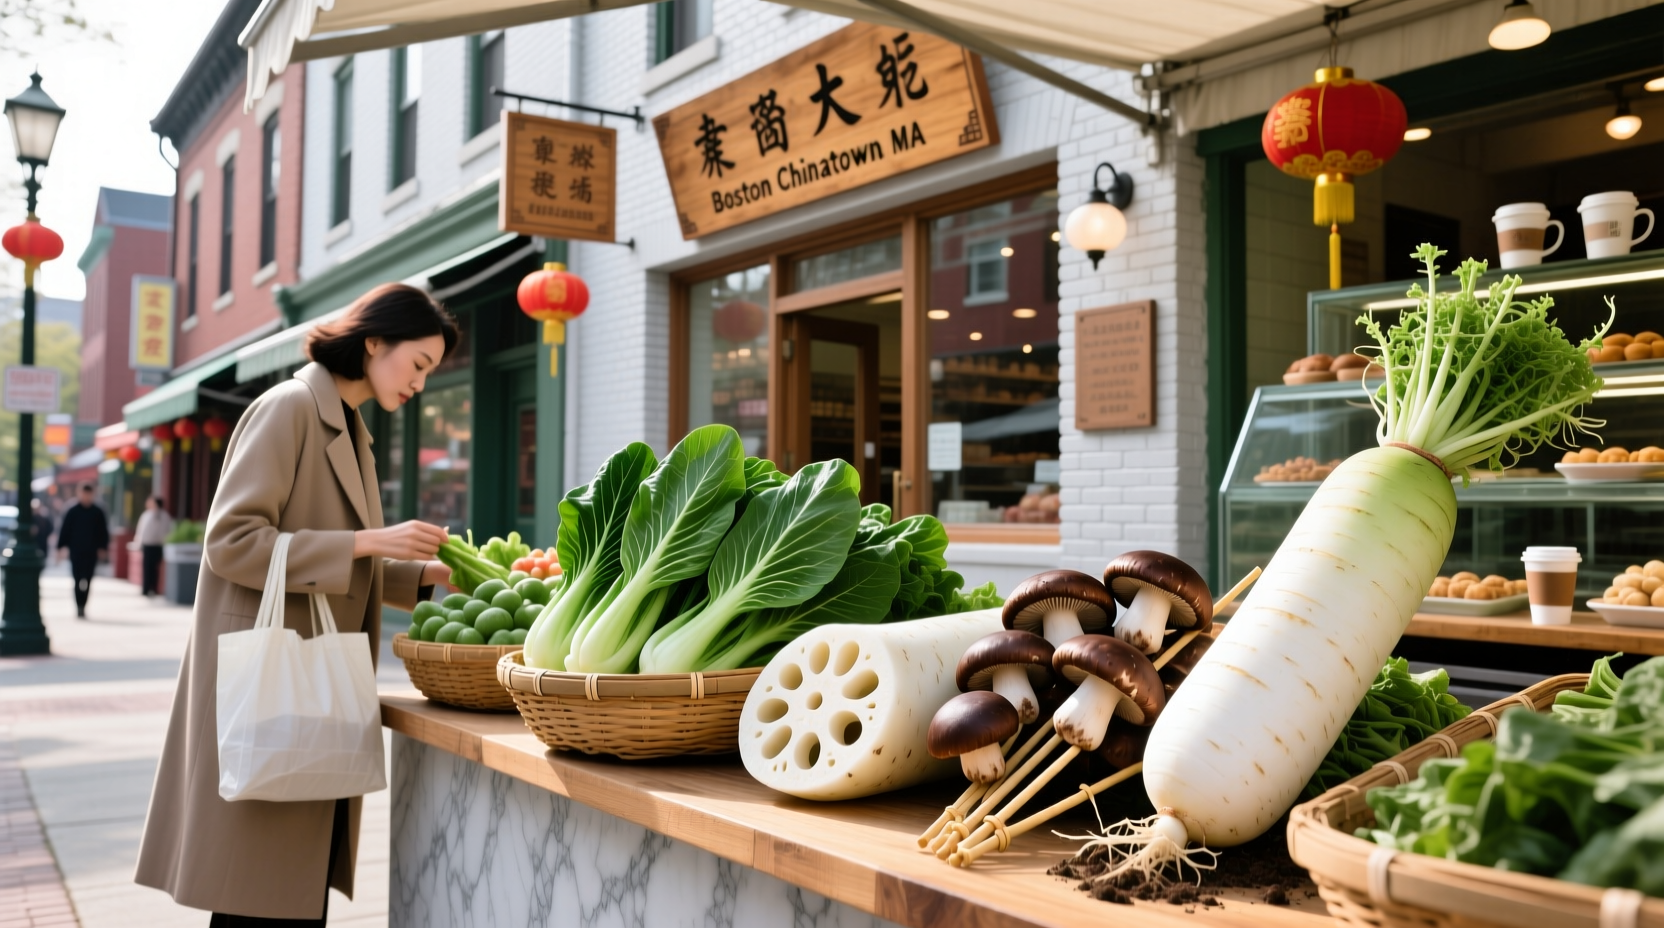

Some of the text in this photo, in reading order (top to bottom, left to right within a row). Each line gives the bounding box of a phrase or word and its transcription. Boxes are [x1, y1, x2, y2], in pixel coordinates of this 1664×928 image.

[711, 121, 927, 214] Boston Chinatown MA
